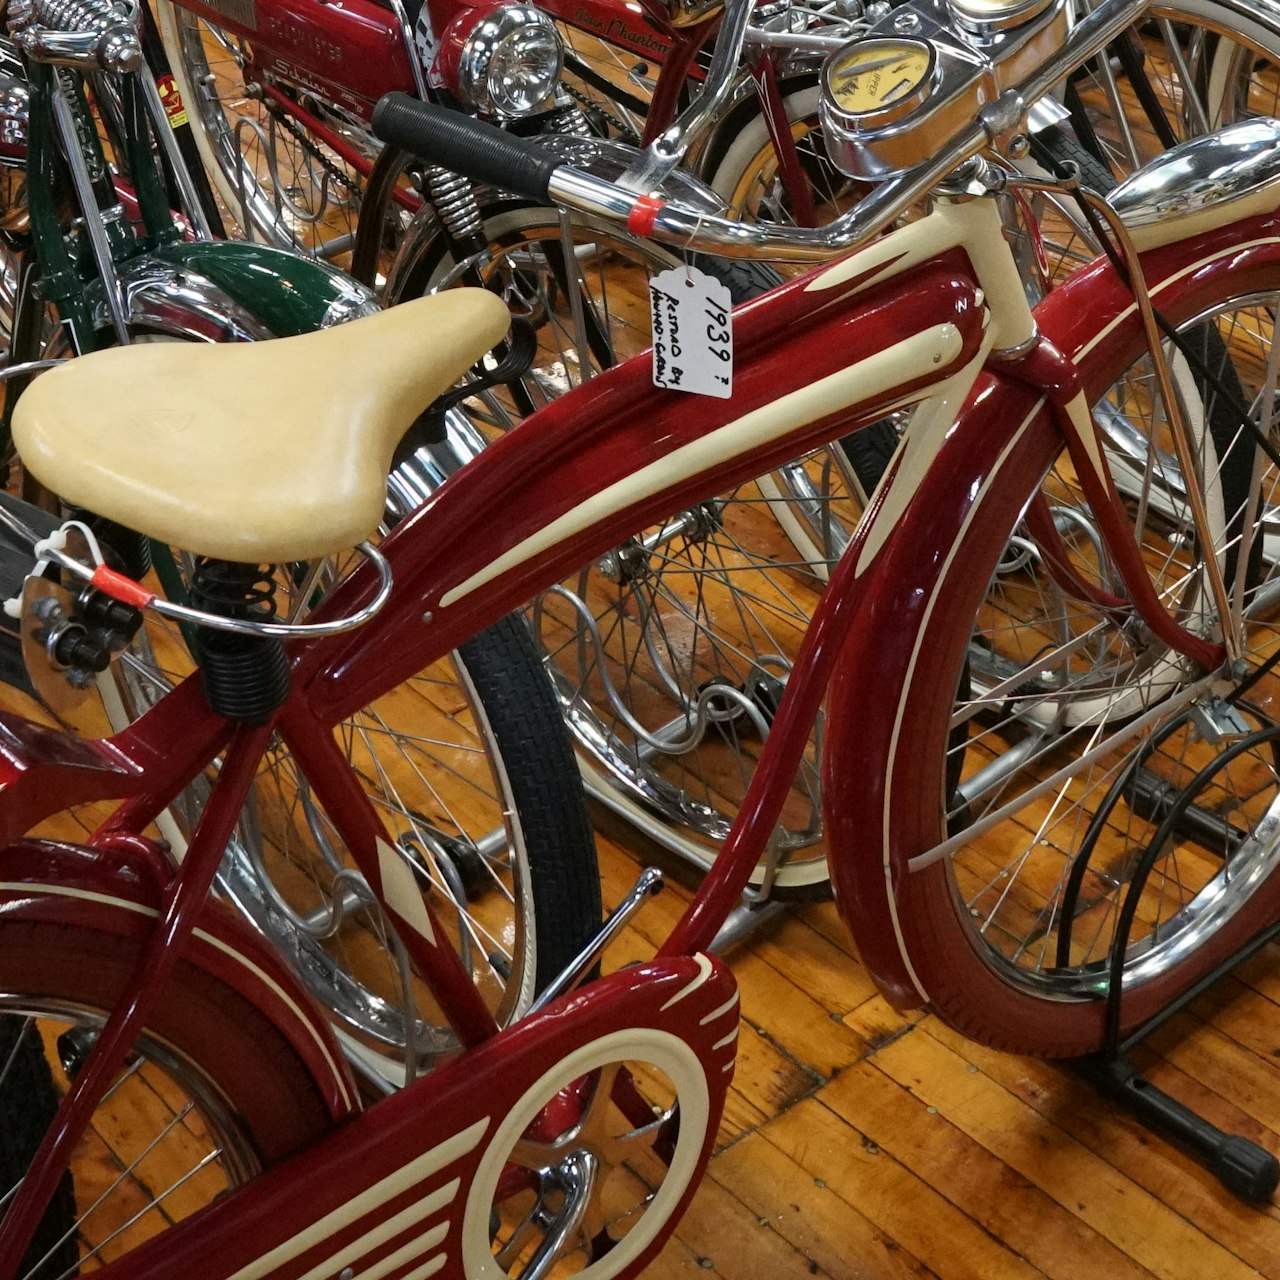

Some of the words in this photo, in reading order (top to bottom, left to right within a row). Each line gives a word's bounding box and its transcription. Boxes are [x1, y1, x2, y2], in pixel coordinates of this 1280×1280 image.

[604, 20, 669, 55] Phantom
[271, 57, 331, 98] Schwinn
[869, 63, 885, 98] LIPPER
[704, 296, 731, 363] 1939
